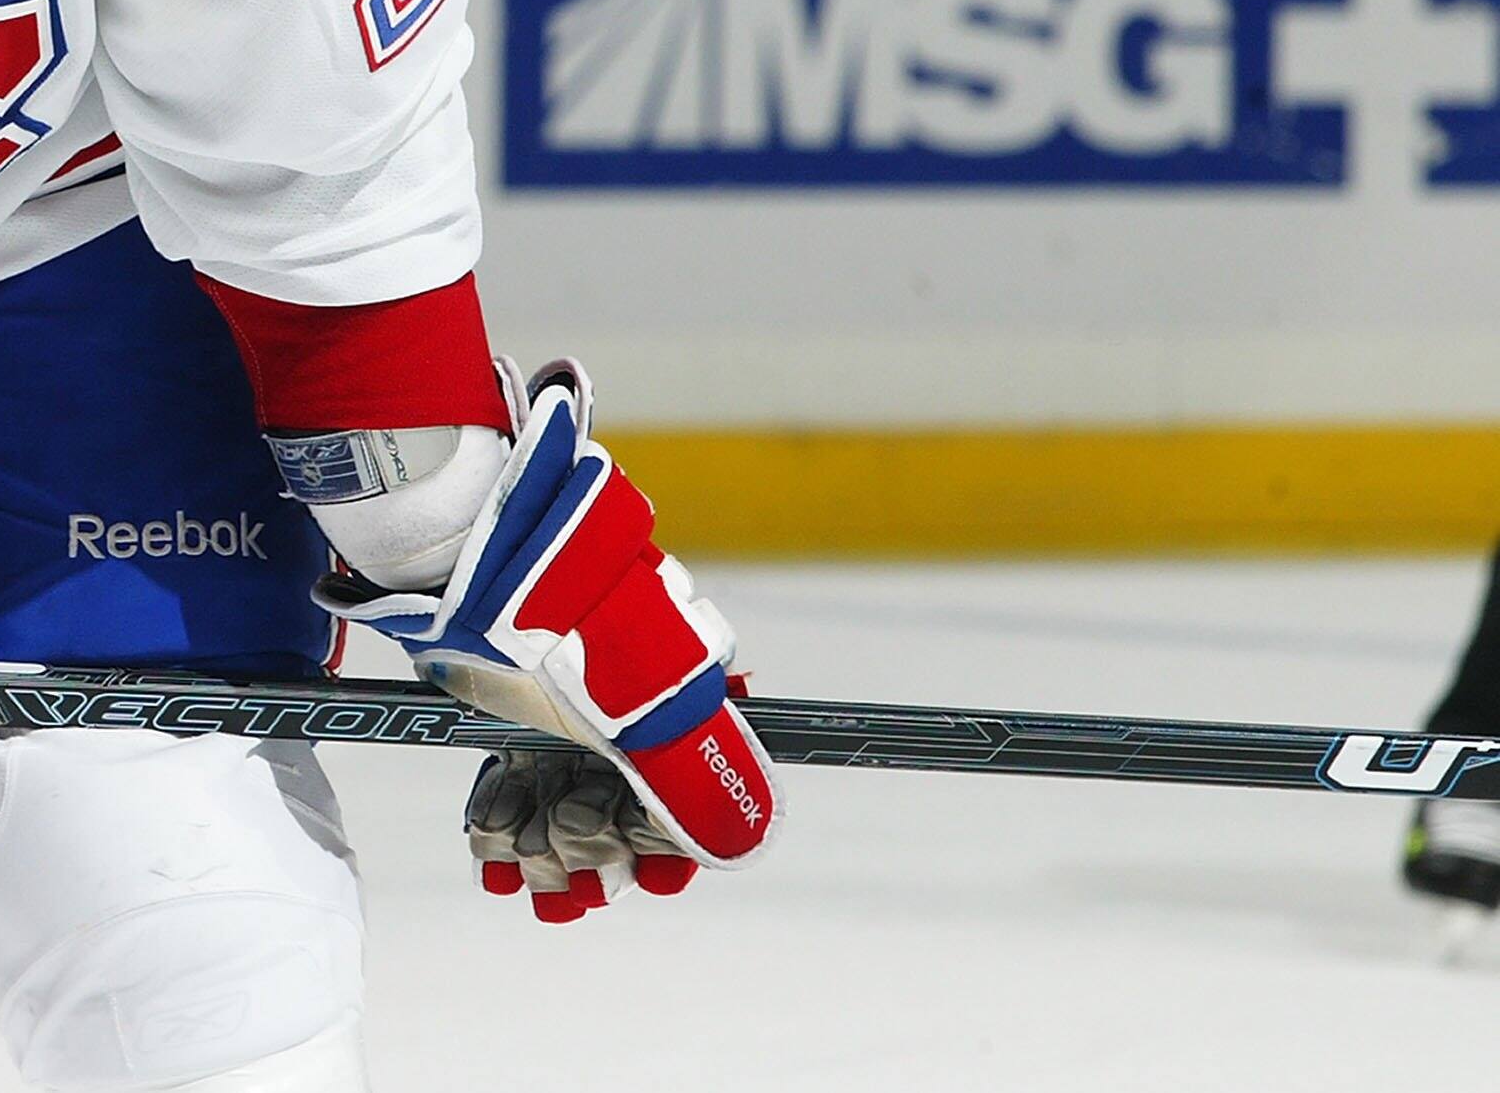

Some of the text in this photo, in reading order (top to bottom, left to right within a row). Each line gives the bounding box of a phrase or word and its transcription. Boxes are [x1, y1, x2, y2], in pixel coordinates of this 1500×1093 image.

[68, 510, 268, 559] Reebok
[6, 688, 467, 743] VECTOR
[697, 735, 763, 830] Reebok
